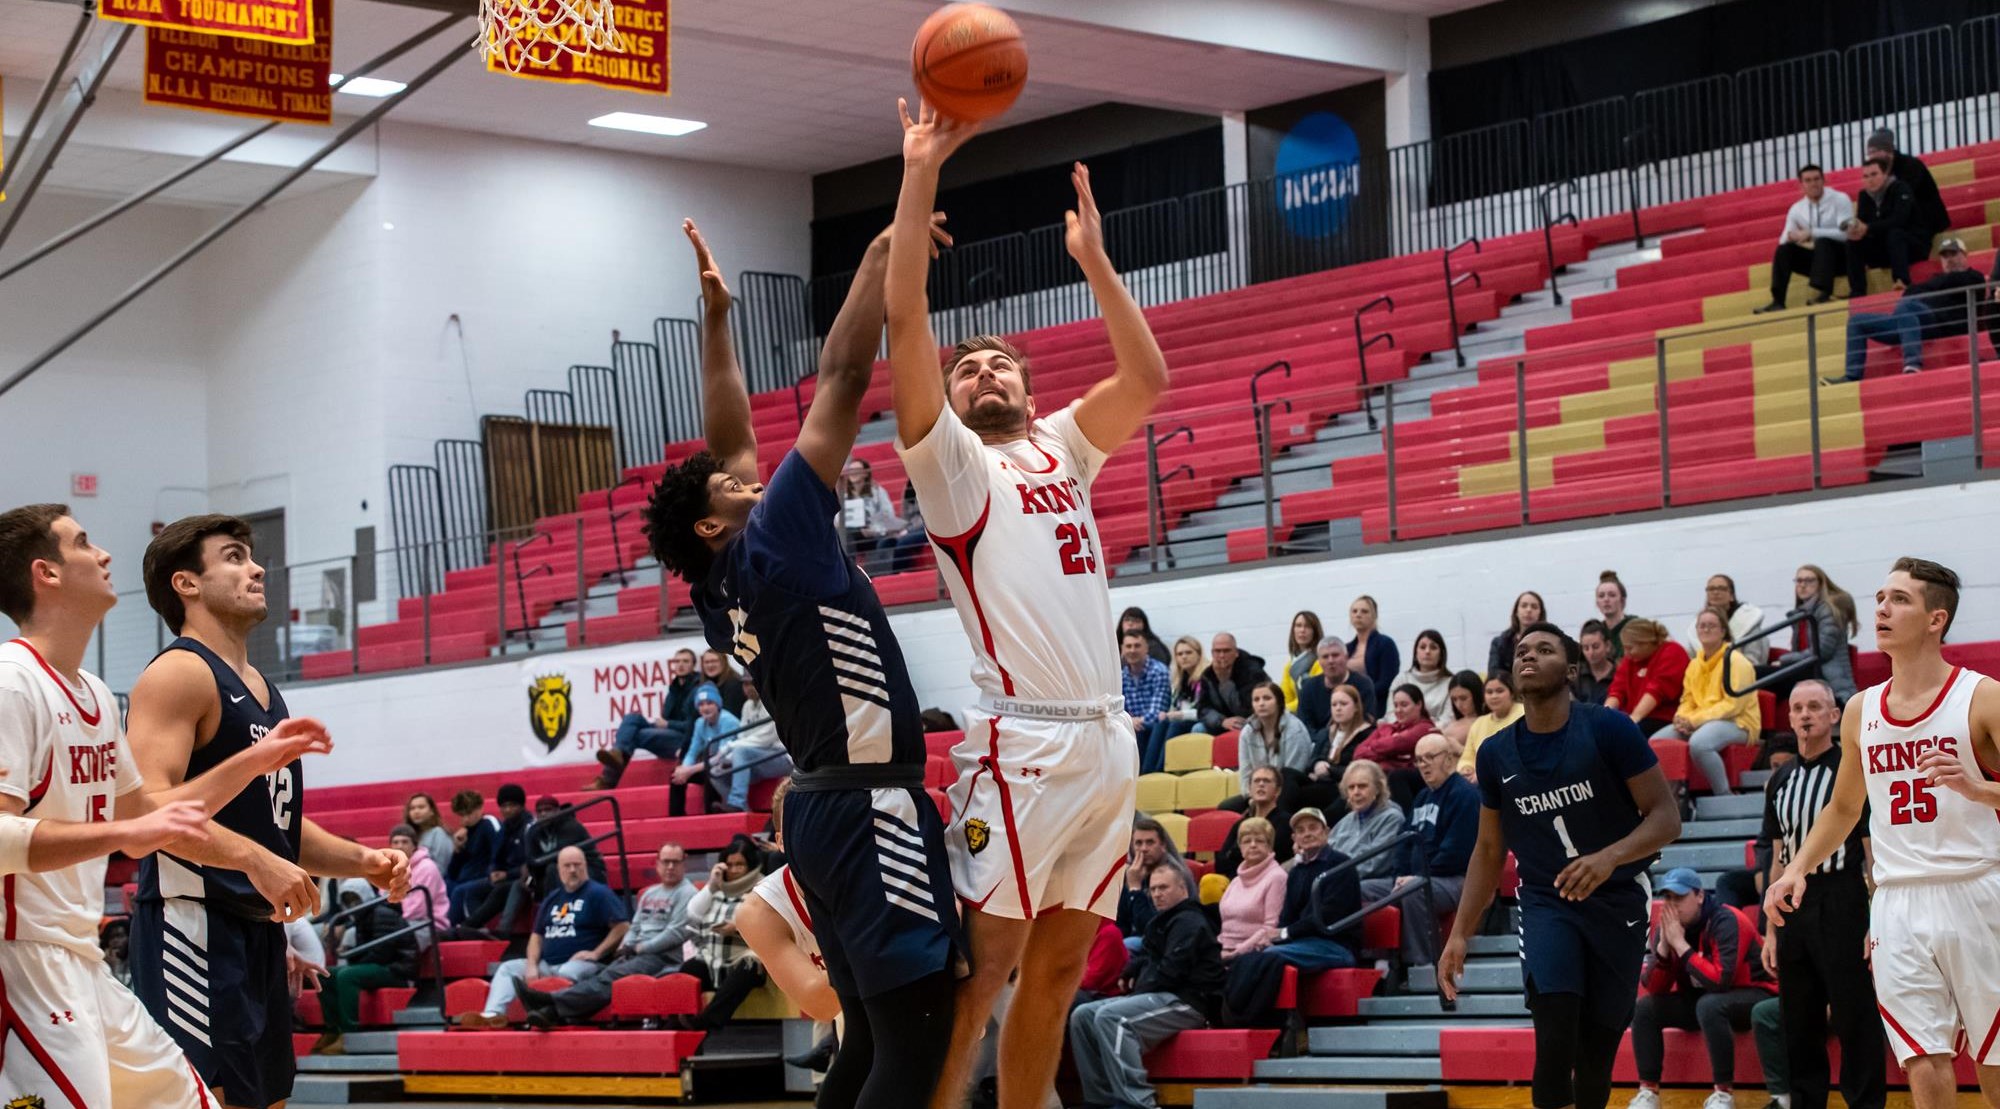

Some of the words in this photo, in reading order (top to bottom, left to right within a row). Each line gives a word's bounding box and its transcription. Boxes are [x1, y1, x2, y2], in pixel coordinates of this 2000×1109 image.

[179, 0, 299, 34] TOURNAMENT
[165, 50, 315, 88] CHAMPIONS
[572, 52, 662, 84] REGIONALS
[210, 82, 277, 110] REGIONAL
[282, 91, 330, 114] FINALS
[1284, 163, 1359, 210] NCAA
[1055, 522, 1096, 575] 23
[594, 659, 679, 693] MONA
[610, 691, 665, 722] NATI
[993, 699, 1080, 717] ARMOUR
[1514, 779, 1595, 815] SCRANTON
[1889, 777, 1938, 826] 25
[1552, 815, 1580, 859] 1
